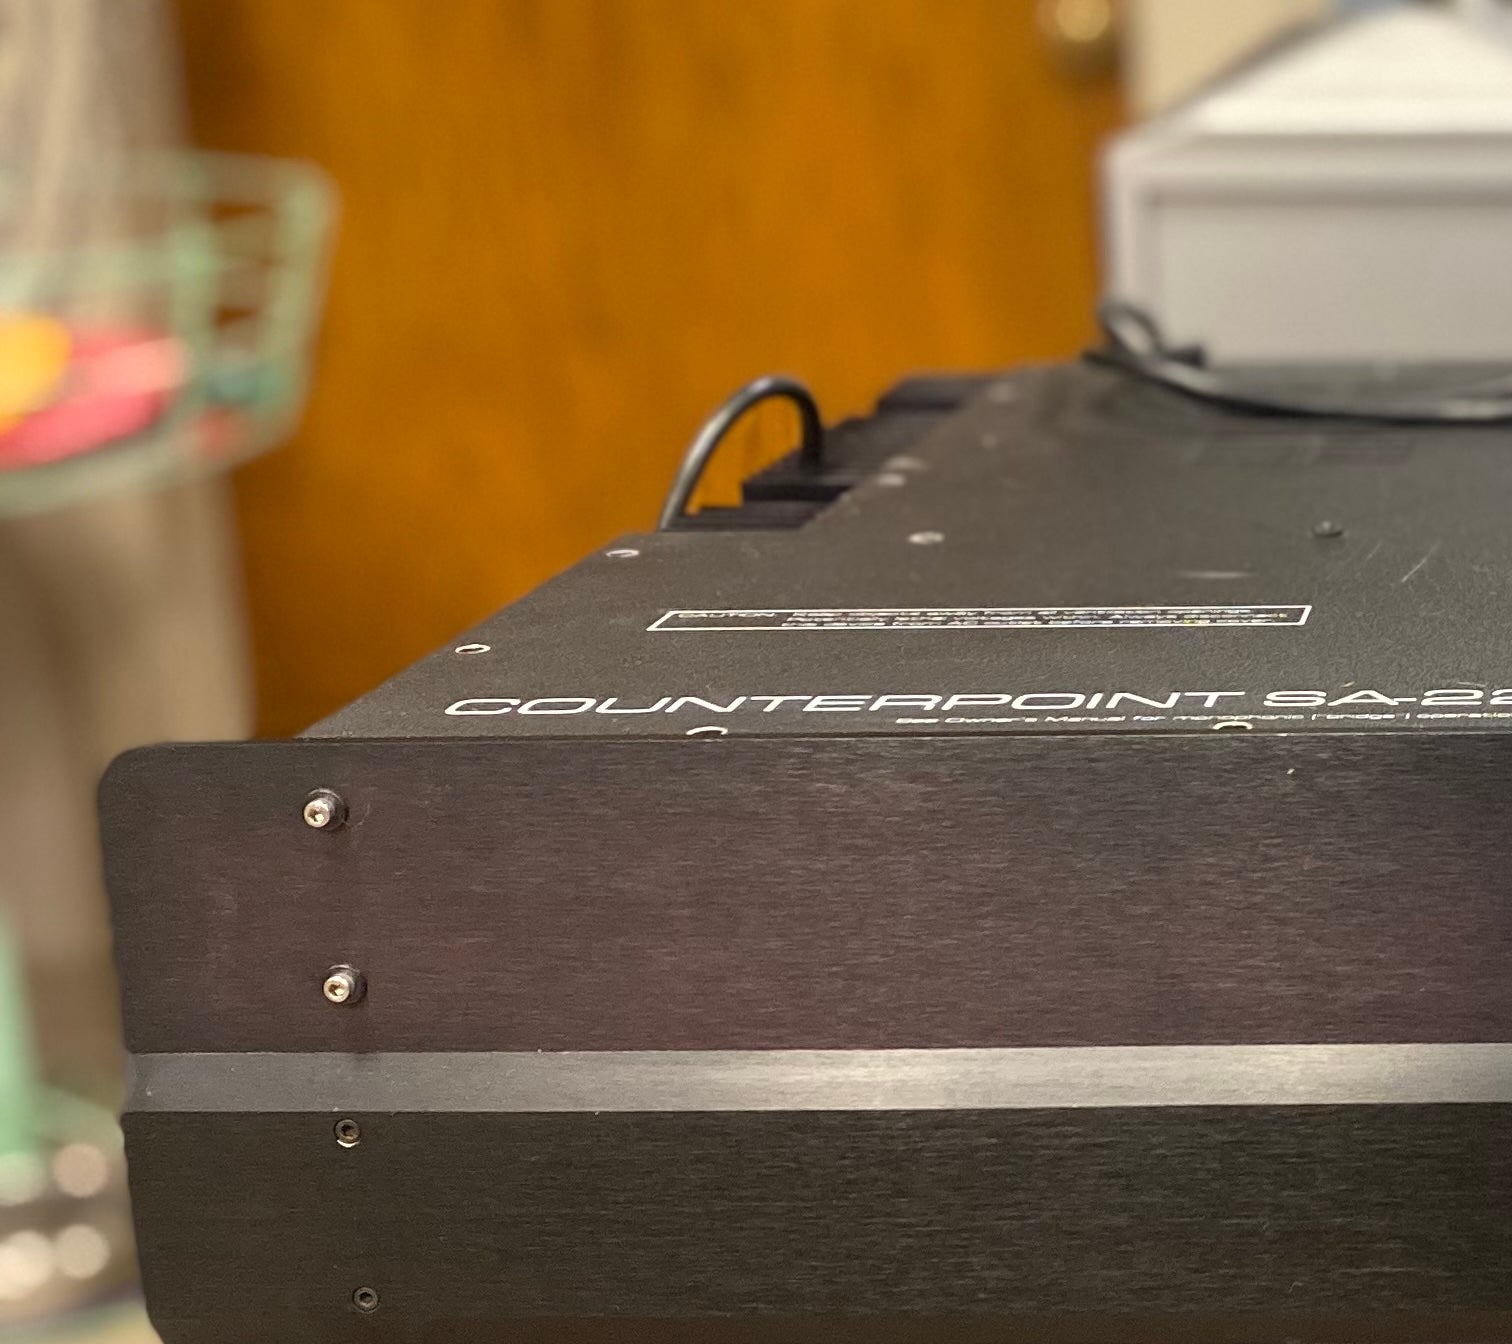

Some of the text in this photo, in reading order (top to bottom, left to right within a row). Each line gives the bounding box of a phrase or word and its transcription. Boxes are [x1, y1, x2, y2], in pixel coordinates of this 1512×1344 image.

[444, 691, 1246, 716] COUNTERPOINT
[1044, 714, 1126, 723] Manual
[1133, 714, 1167, 722] for
[1173, 713, 1305, 722] monophonic
